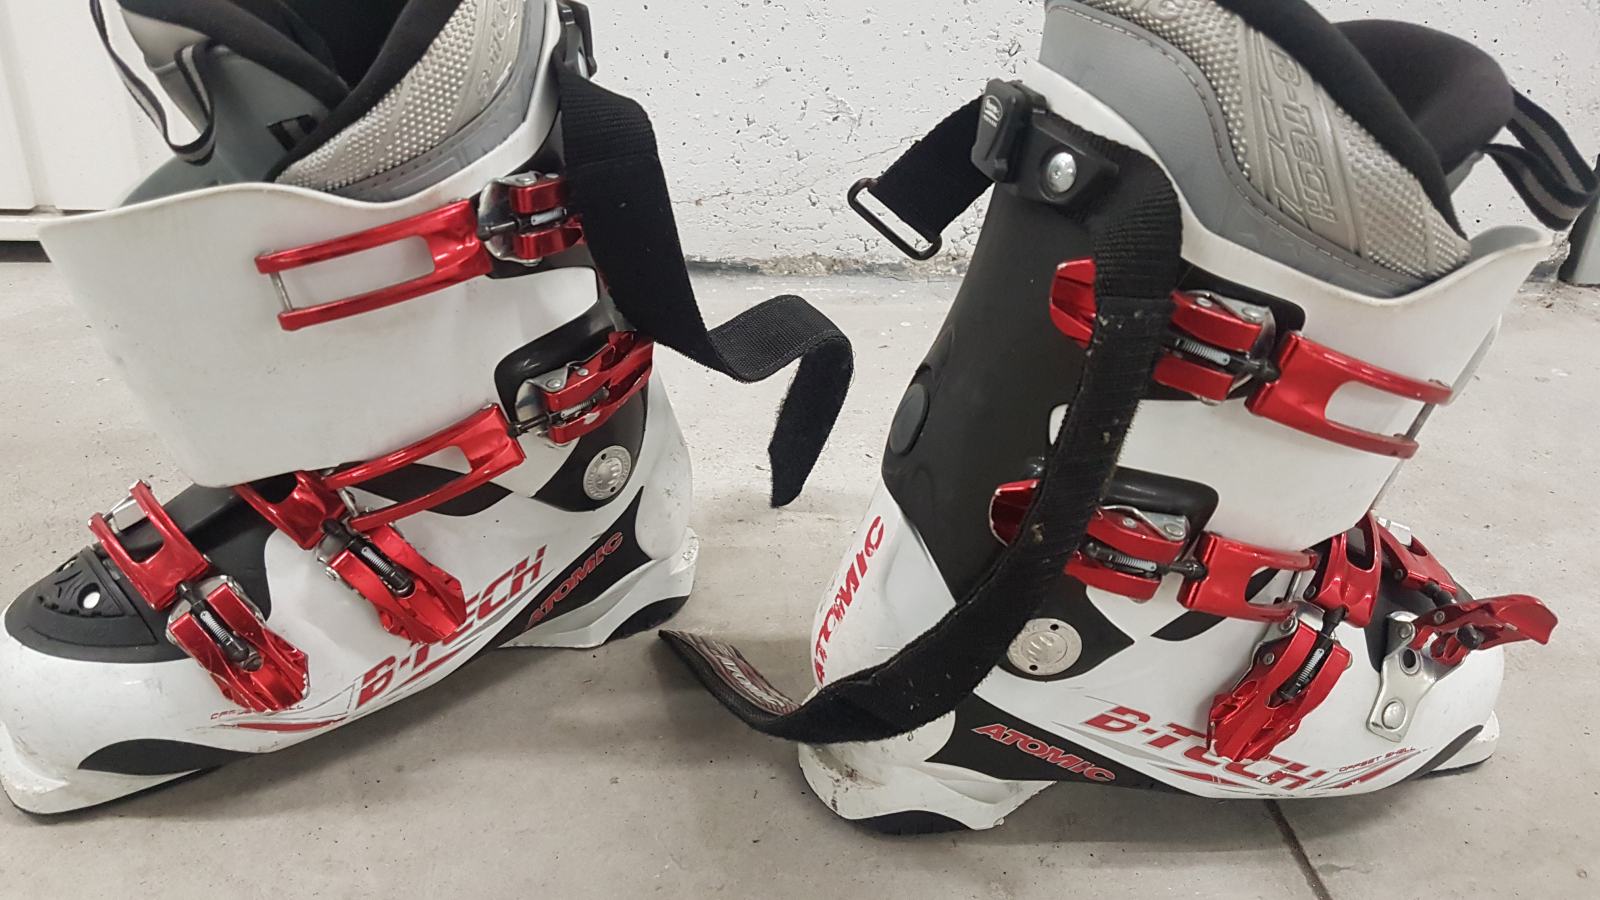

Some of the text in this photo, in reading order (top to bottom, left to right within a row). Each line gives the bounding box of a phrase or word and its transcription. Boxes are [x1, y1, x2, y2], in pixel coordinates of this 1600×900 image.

[526, 531, 624, 631] ATOMIC
[814, 515, 885, 687] ATOMIC
[971, 723, 1116, 782] ATOMIC
